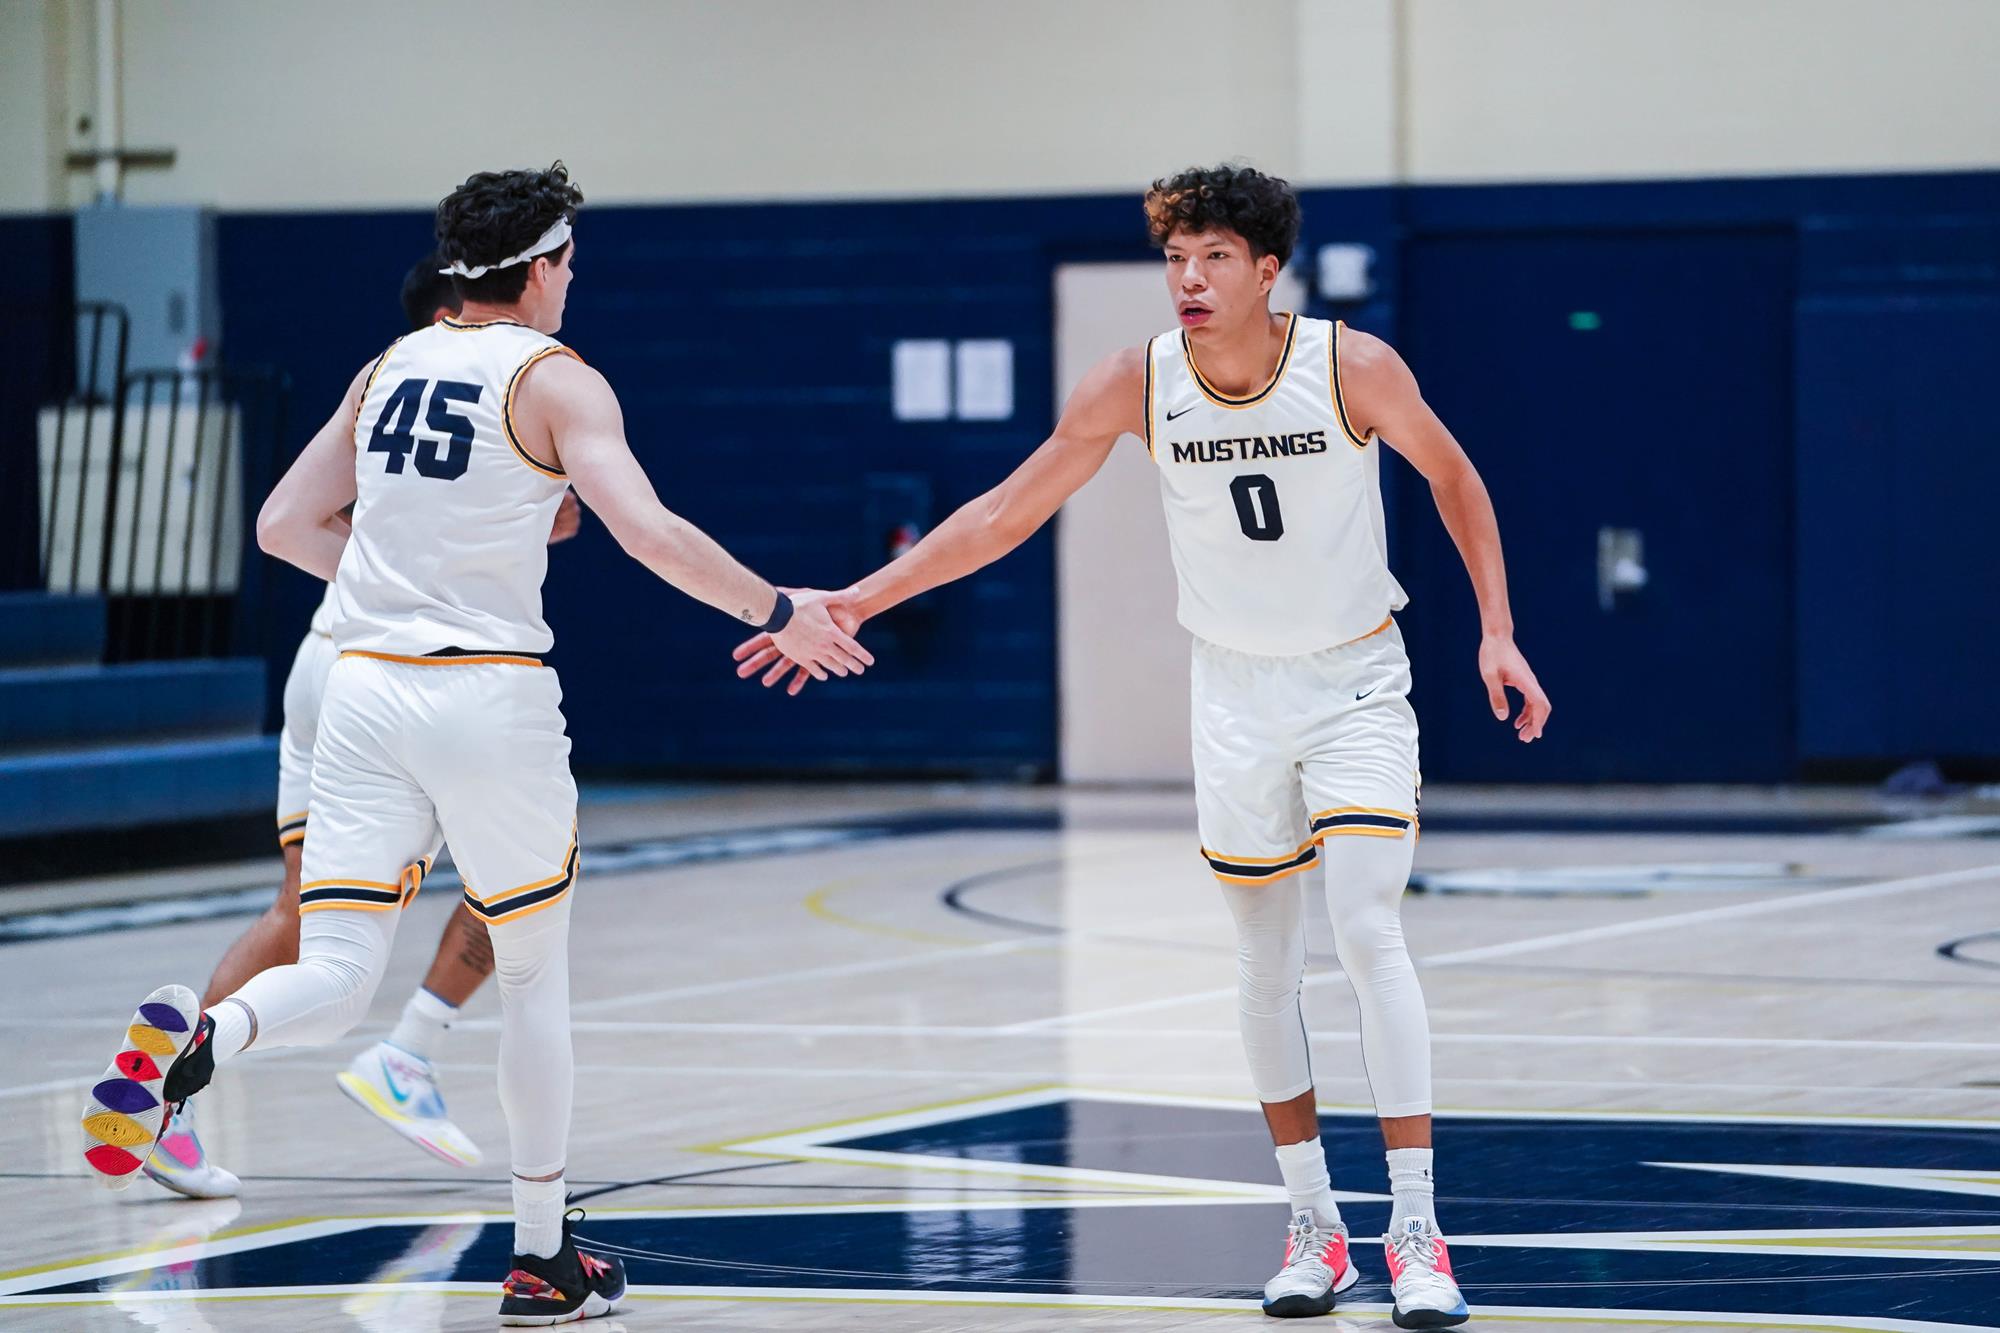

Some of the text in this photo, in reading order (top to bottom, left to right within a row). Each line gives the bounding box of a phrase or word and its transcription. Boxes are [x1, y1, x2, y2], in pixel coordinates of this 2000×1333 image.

[367, 378, 484, 481] 45
[1170, 430, 1327, 463] MUSTANGS
[1229, 473, 1284, 542] 0
